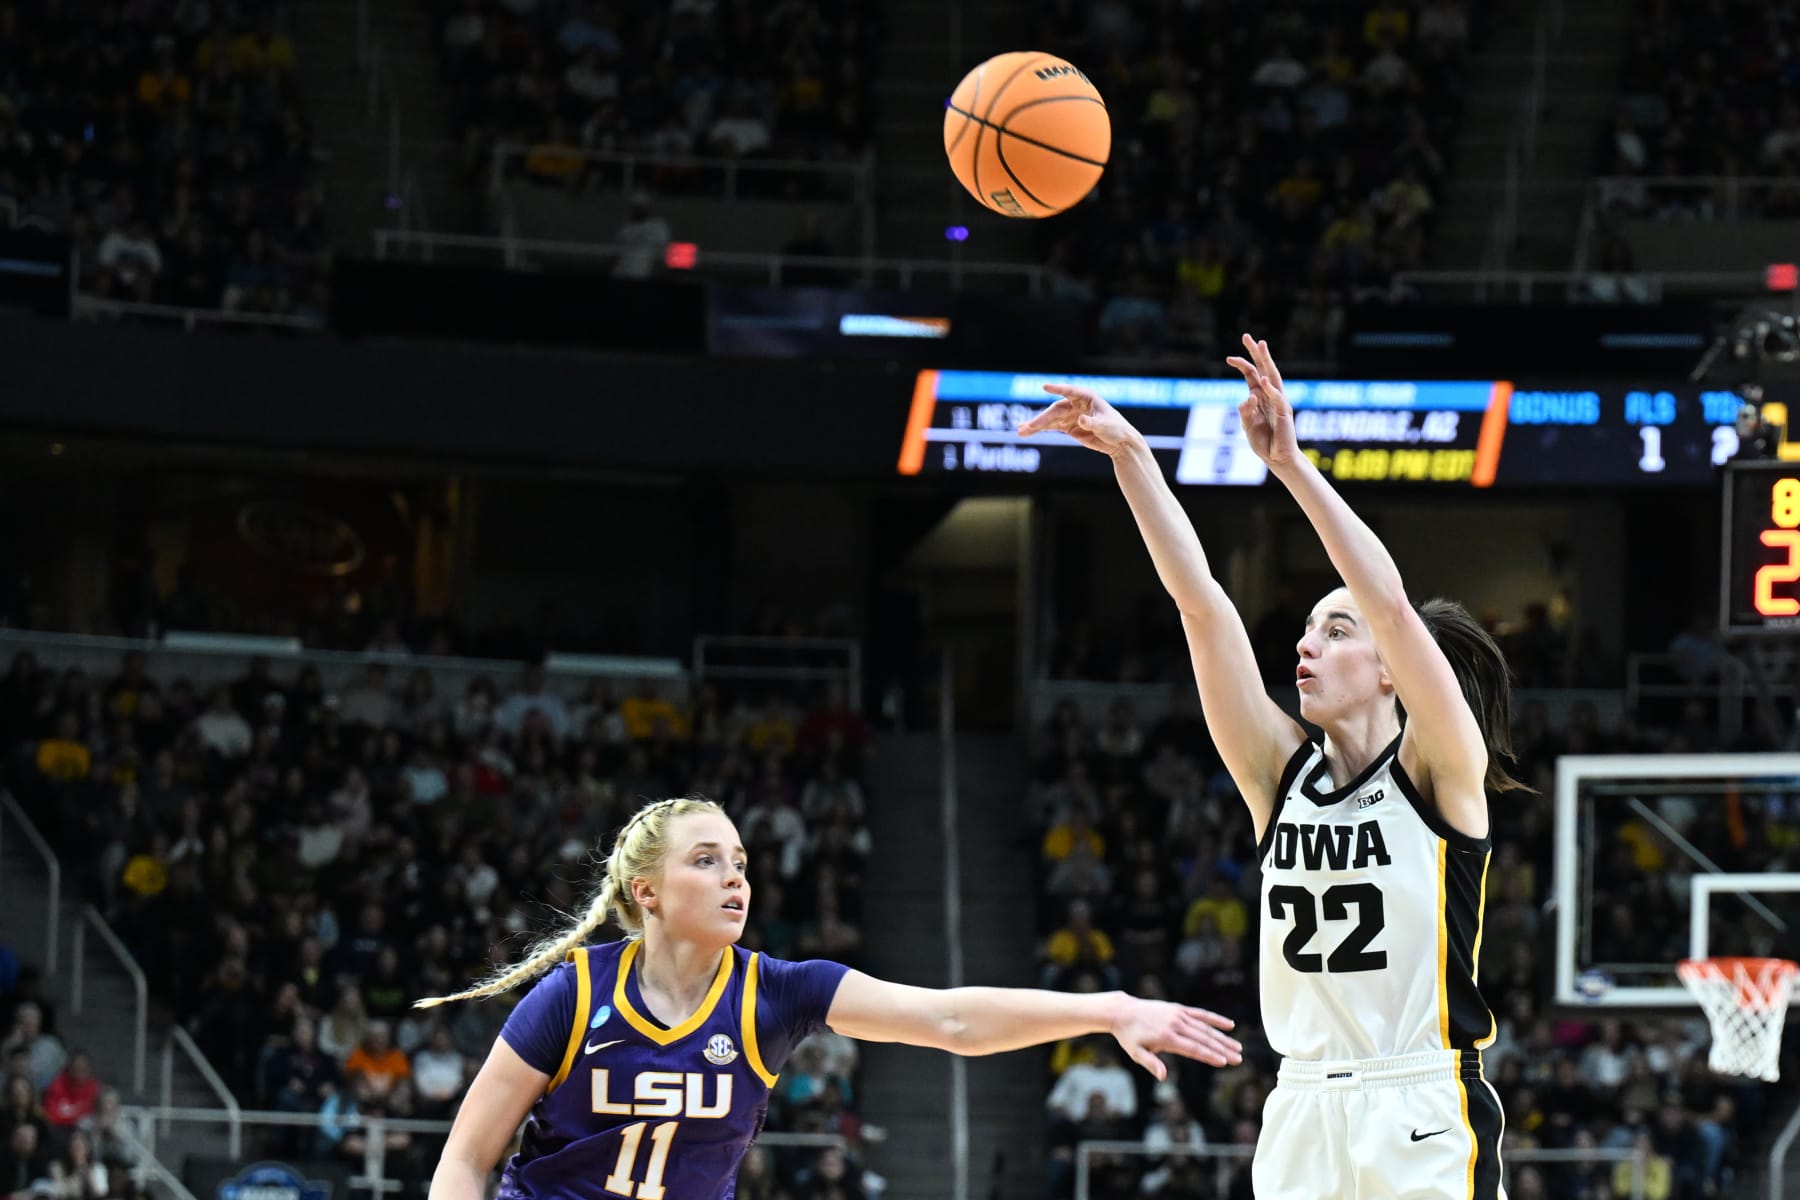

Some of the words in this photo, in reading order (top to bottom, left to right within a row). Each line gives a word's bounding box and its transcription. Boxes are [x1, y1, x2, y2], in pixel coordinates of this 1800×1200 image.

[1508, 391, 1600, 424] BONUS
[963, 442, 1040, 472] Purdue
[1639, 426, 1665, 472] 1
[1269, 820, 1391, 870] OWA
[1268, 883, 1387, 973] 22
[710, 1037, 732, 1057] SEC
[591, 1068, 733, 1119] LSU
[604, 1121, 680, 1200] 11
